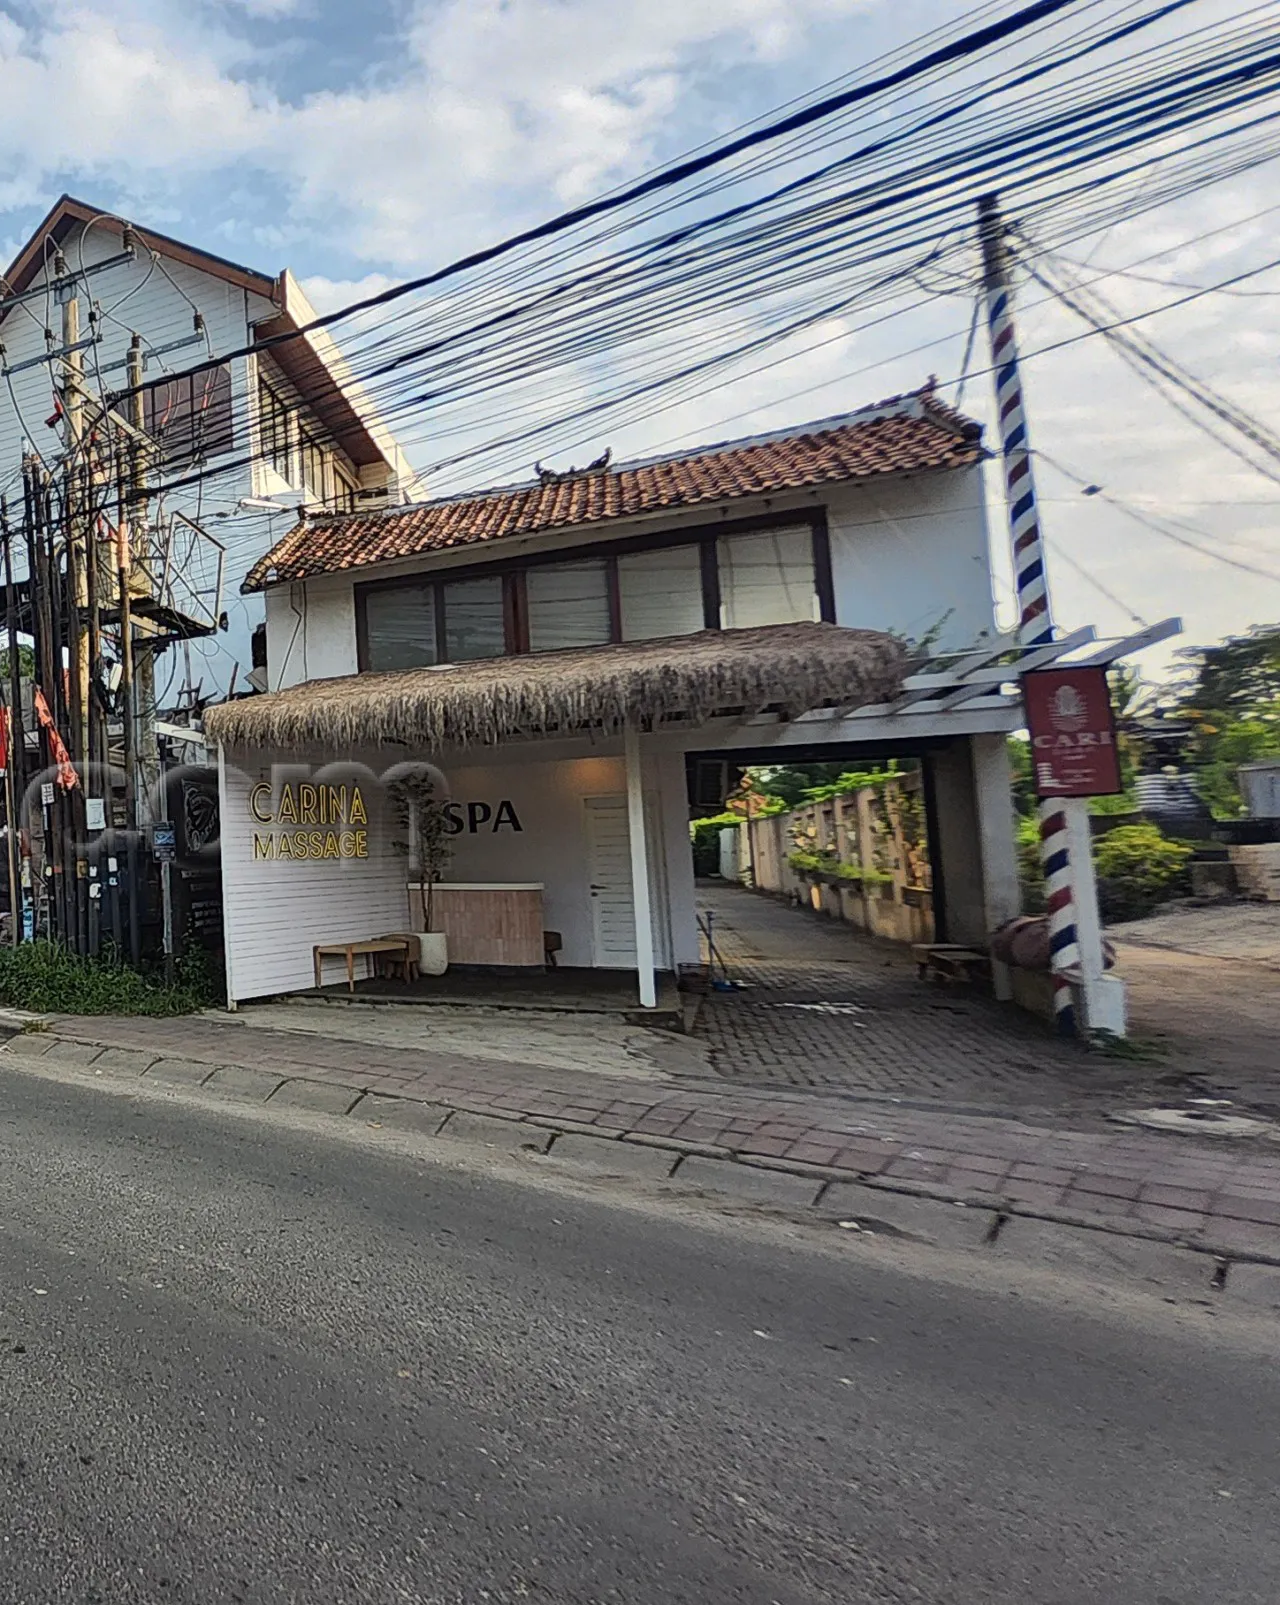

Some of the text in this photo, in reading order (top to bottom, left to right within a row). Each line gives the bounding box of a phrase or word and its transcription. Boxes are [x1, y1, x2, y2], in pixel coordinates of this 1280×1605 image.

[1033, 731, 1112, 749] CARI
[249, 782, 368, 825] CARINA
[442, 800, 524, 835] SPA
[253, 830, 368, 860] MASSAGE
